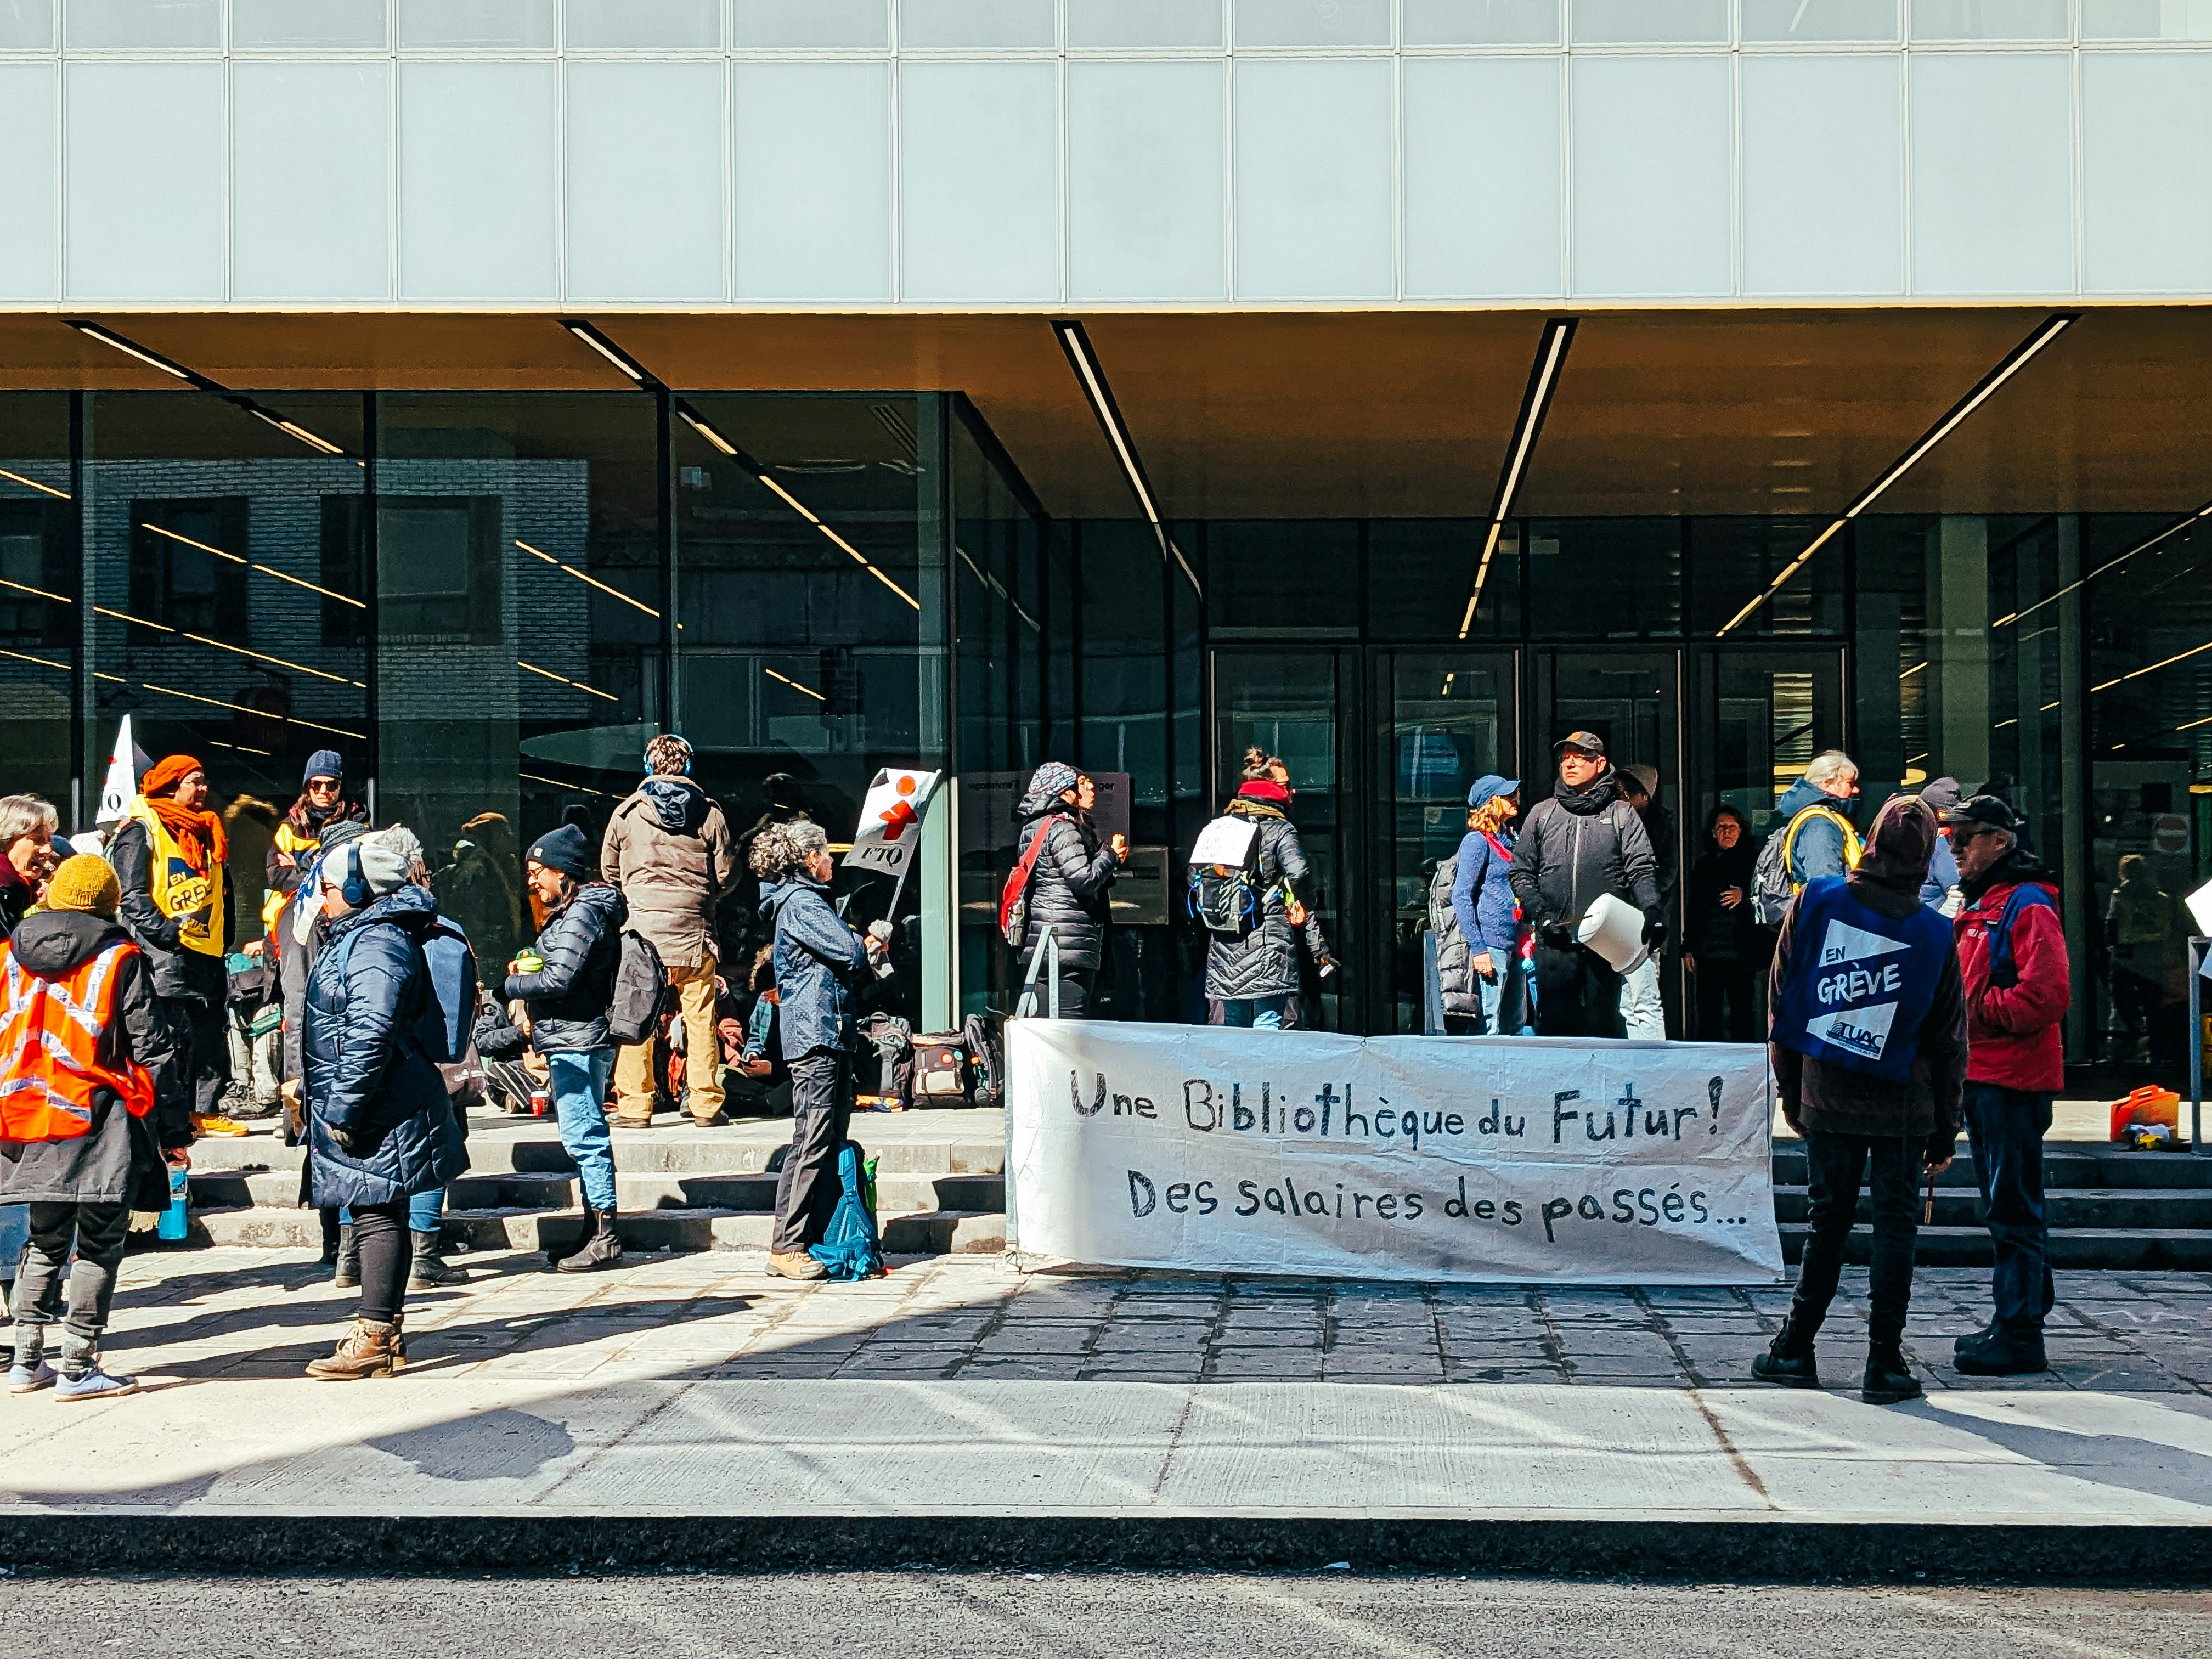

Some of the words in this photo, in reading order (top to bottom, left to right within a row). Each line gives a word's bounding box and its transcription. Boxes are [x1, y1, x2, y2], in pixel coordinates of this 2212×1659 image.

[169, 871, 187, 886] EN
[1826, 946, 1846, 963] EN
[1817, 962, 1902, 1005] GRÈVE
[1070, 1069, 1158, 1120] Une
[1182, 1078, 1465, 1153] Bibliothèque
[1478, 1098, 1525, 1138] du
[1553, 1075, 1724, 1144] Futur!
[1127, 1170, 1218, 1218] Des
[1235, 1176, 1424, 1221] salaires
[1443, 1175, 1523, 1226] des
[1541, 1182, 1748, 1243] passés...
